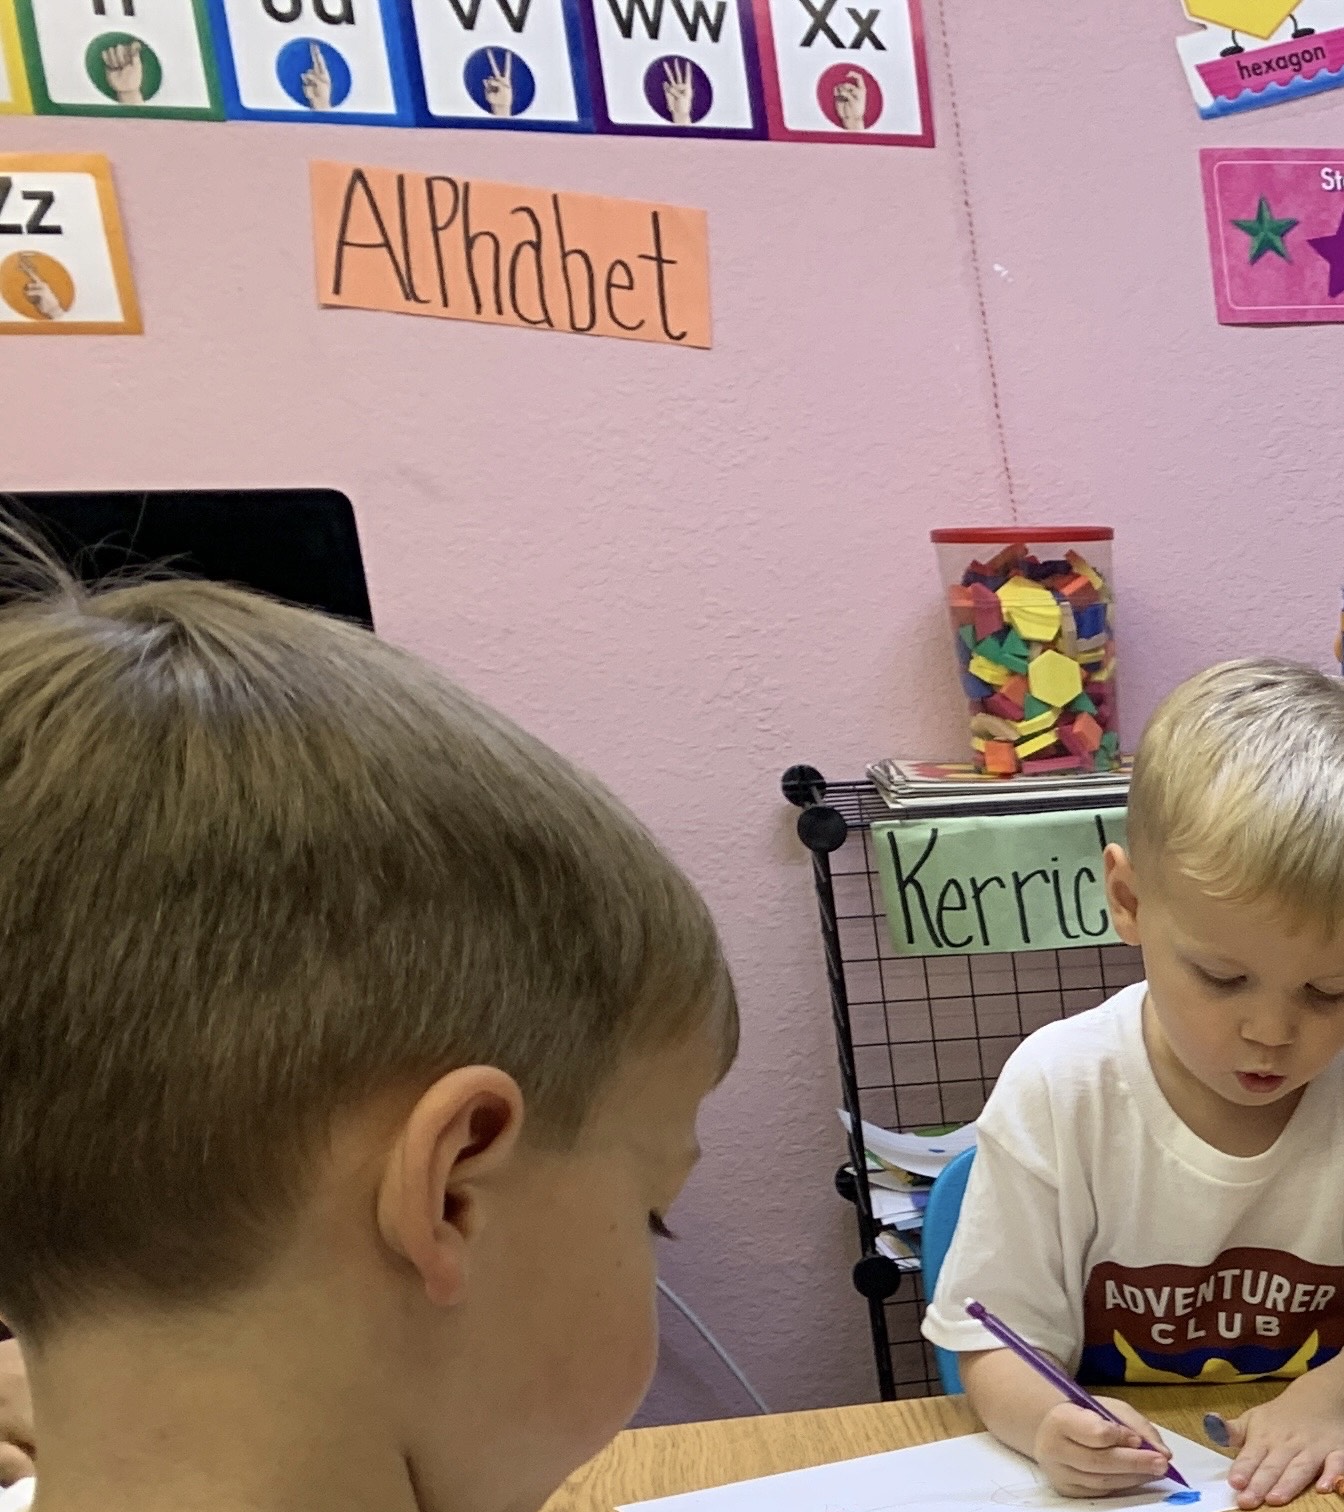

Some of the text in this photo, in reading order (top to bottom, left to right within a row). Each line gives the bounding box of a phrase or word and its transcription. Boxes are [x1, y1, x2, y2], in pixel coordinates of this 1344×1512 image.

[799, 0, 886, 51] Xx
[1236, 46, 1326, 80] hexagon
[1104, 1267, 1337, 1319] ADVENTURER
[1150, 1310, 1282, 1346] CLUB
